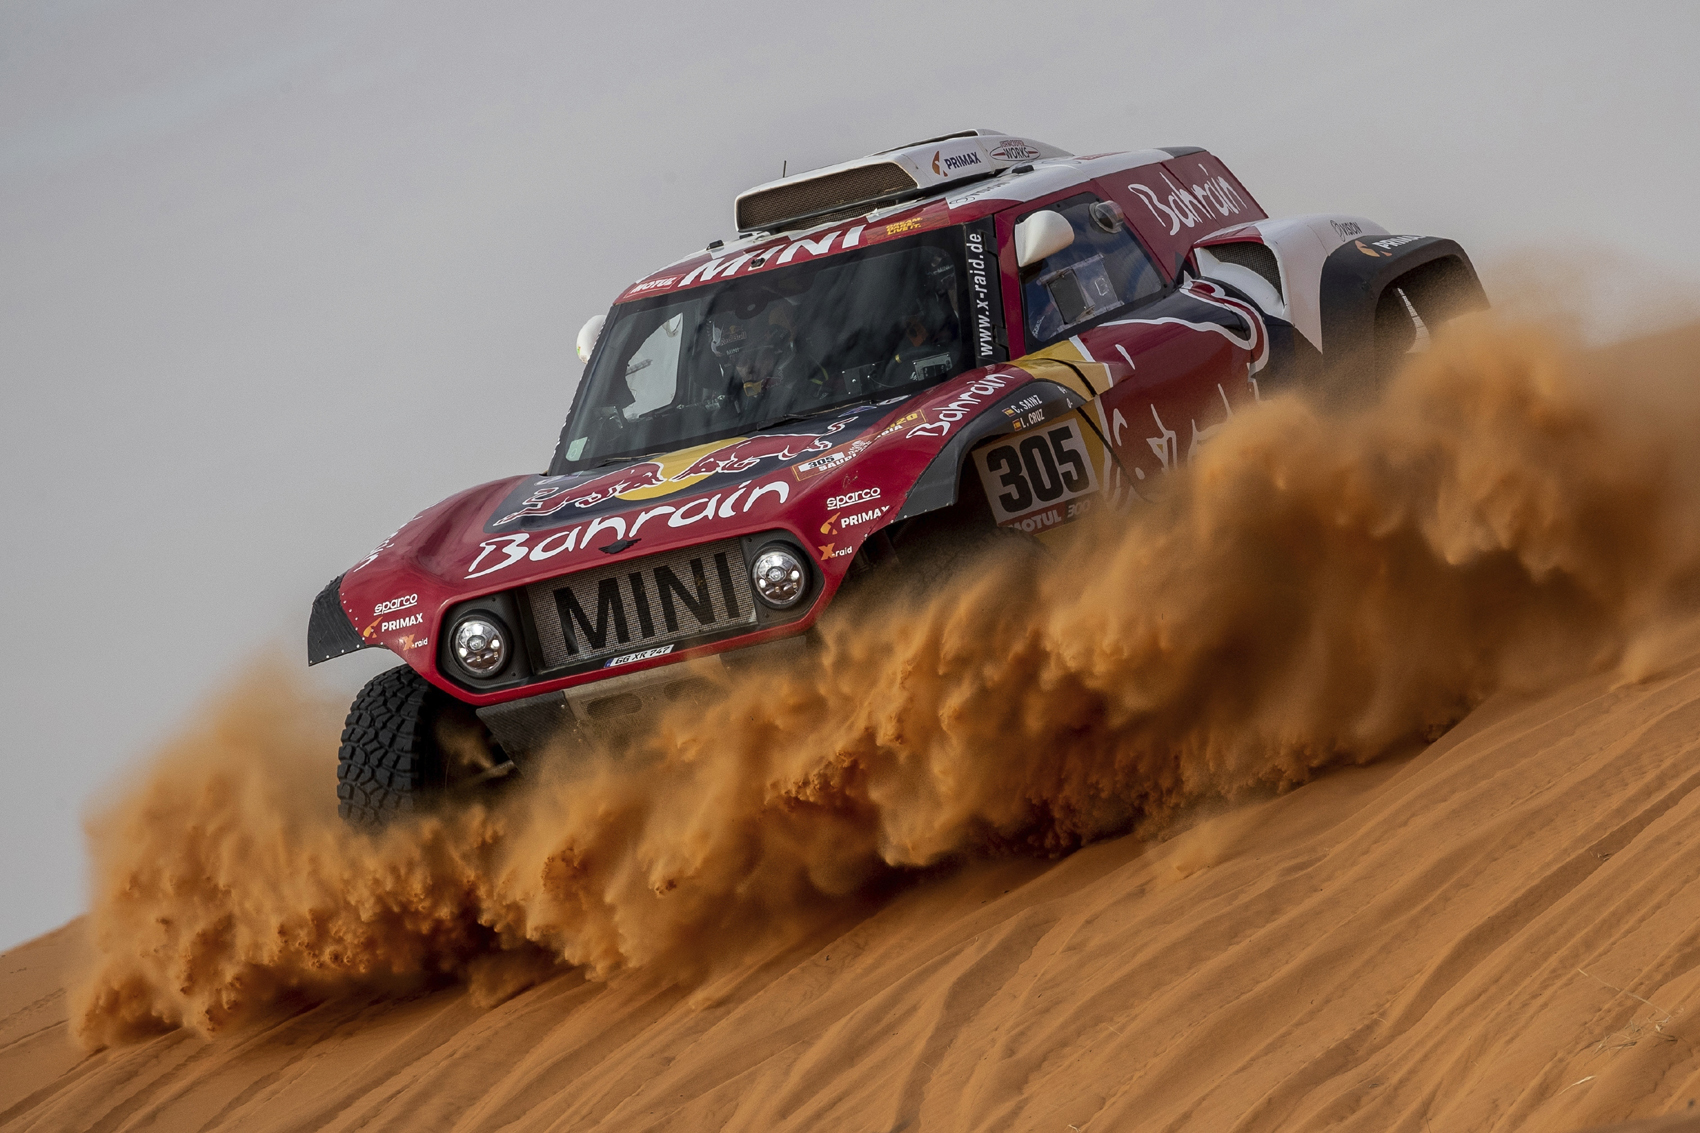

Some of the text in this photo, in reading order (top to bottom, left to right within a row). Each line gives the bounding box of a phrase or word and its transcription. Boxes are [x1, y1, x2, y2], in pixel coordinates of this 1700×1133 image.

[944, 151, 982, 170] PRIMAX
[1002, 146, 1031, 160] WORKS
[1128, 163, 1248, 236] Bahrain
[677, 224, 867, 288] MINI
[630, 276, 678, 294] MOTUL
[966, 233, 993, 356] www.x-raid.de
[906, 373, 1015, 439] Bahrain
[1010, 394, 1043, 414] C. SAINZ
[1020, 408, 1045, 428] L. CRUZ
[808, 455, 835, 469] 305
[986, 425, 1090, 514] 305
[826, 487, 881, 510] sparco
[464, 480, 790, 580] Bahrain
[373, 593, 418, 616] sparco
[553, 551, 741, 656] MINI
[381, 612, 424, 633] PRIMAX
[632, 651, 647, 661] XR
